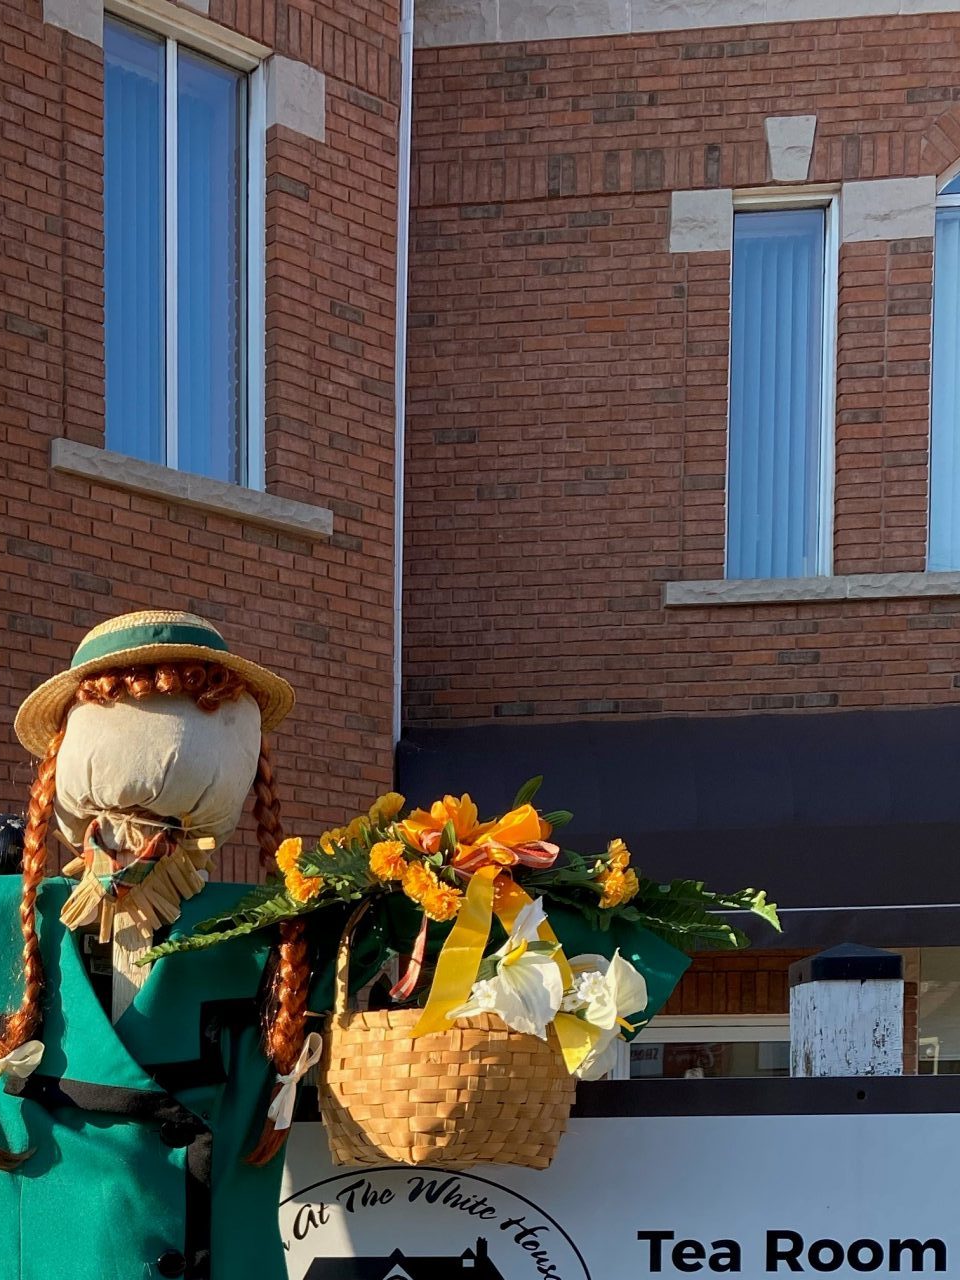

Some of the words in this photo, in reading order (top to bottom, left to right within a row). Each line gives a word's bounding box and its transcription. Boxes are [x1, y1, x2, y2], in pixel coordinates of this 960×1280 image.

[293, 1202, 330, 1240] At
[336, 1179, 395, 1213] The
[407, 1177, 497, 1220] White
[637, 1230, 741, 1272] Tea
[765, 1229, 947, 1272] Room
